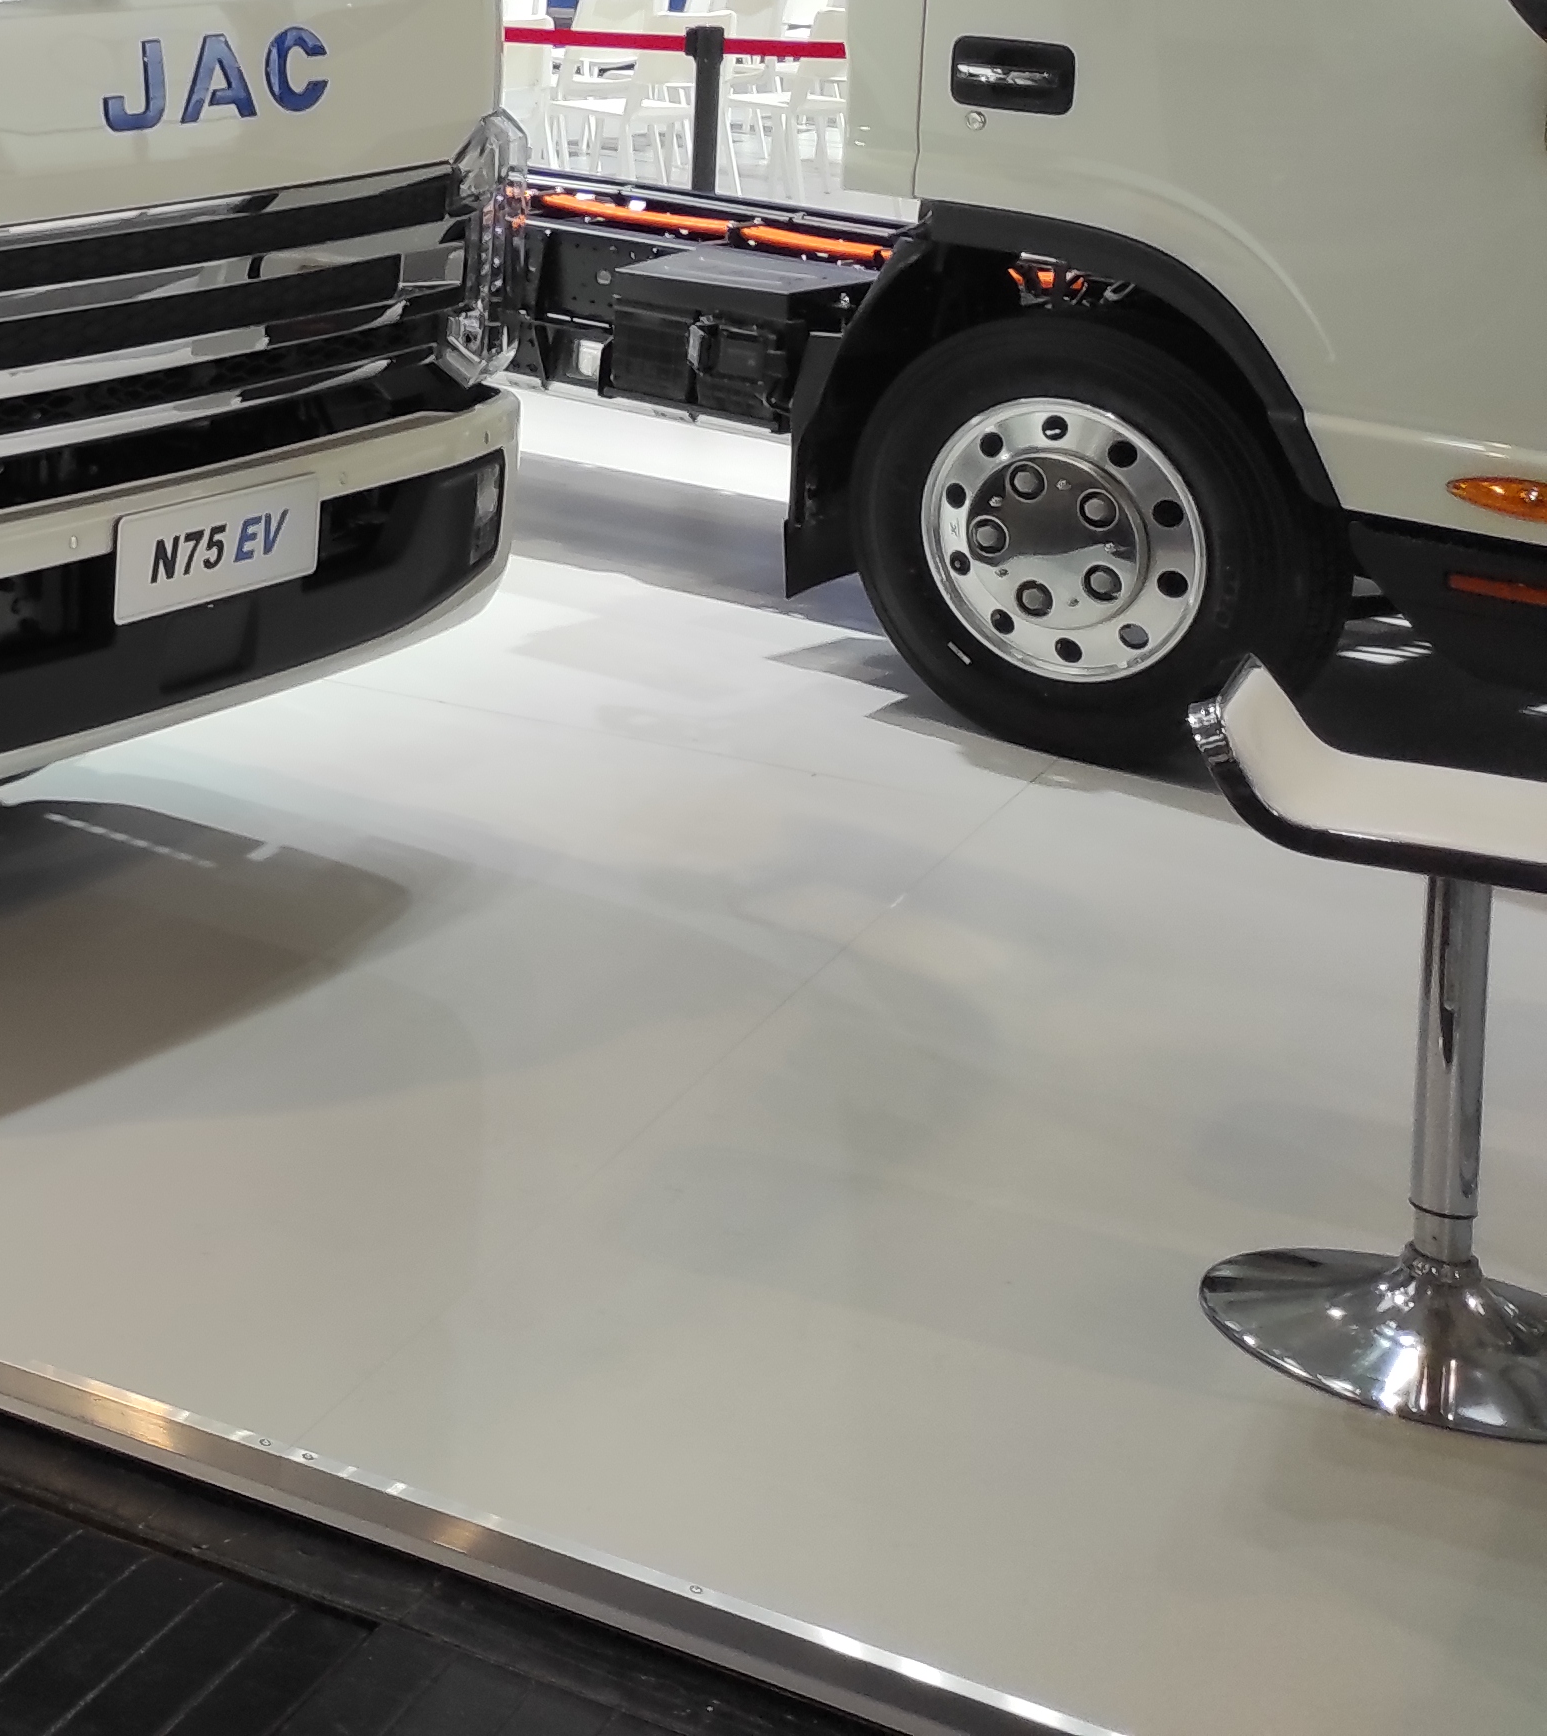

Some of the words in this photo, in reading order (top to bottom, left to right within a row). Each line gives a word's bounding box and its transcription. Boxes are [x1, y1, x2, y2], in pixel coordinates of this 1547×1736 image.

[102, 25, 329, 133] JAC
[149, 522, 229, 584] N75
[233, 507, 290, 563] EV
